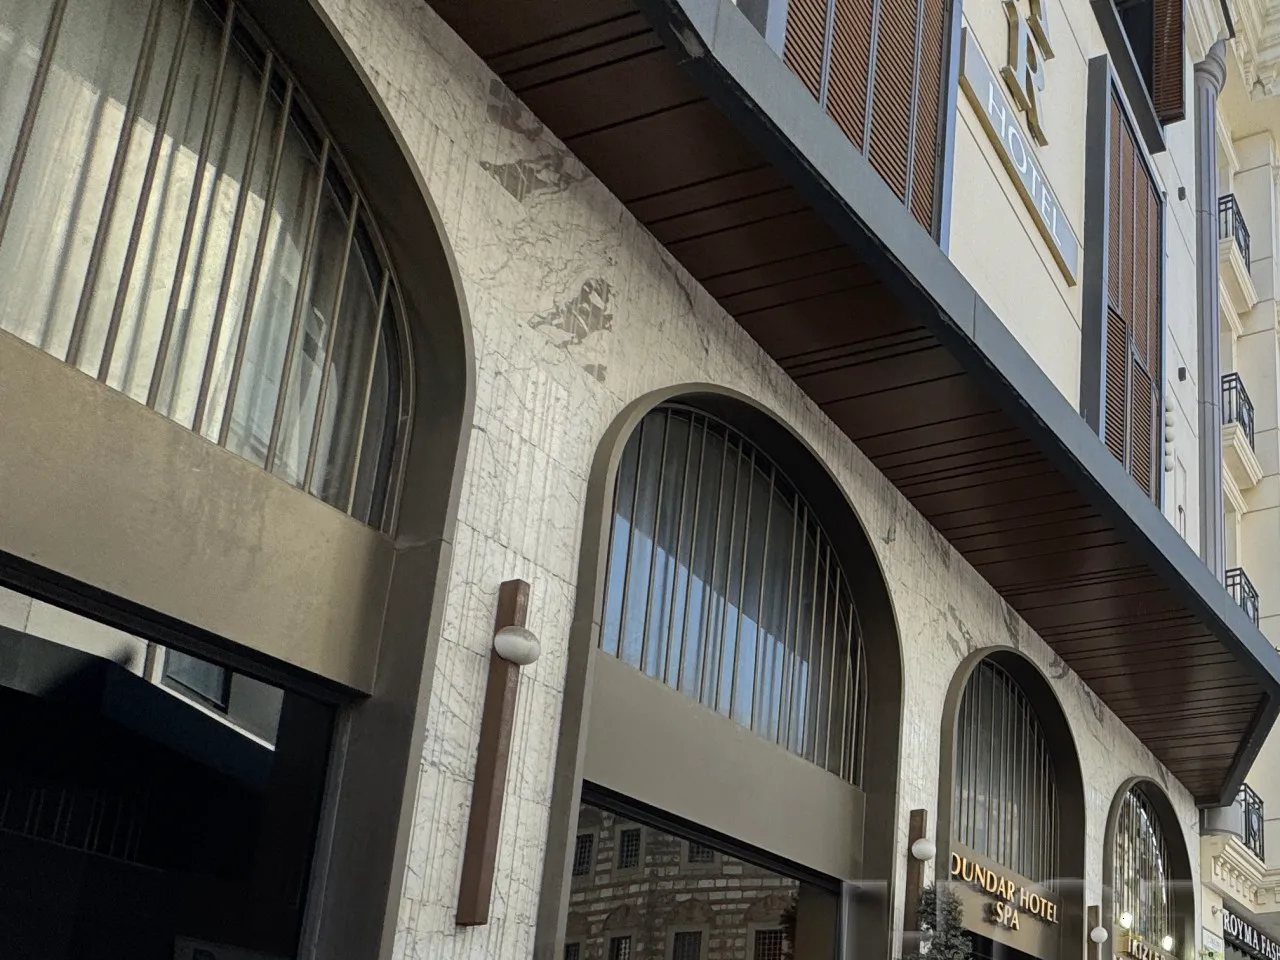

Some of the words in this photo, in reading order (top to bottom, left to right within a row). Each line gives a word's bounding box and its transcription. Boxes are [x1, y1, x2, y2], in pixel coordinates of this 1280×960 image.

[987, 81, 1062, 247] HOTEL
[951, 851, 1016, 903] DUNDAR
[1019, 887, 1059, 924] HOTEL
[996, 901, 1020, 931] SPA
[1223, 909, 1260, 951] ROYMA
